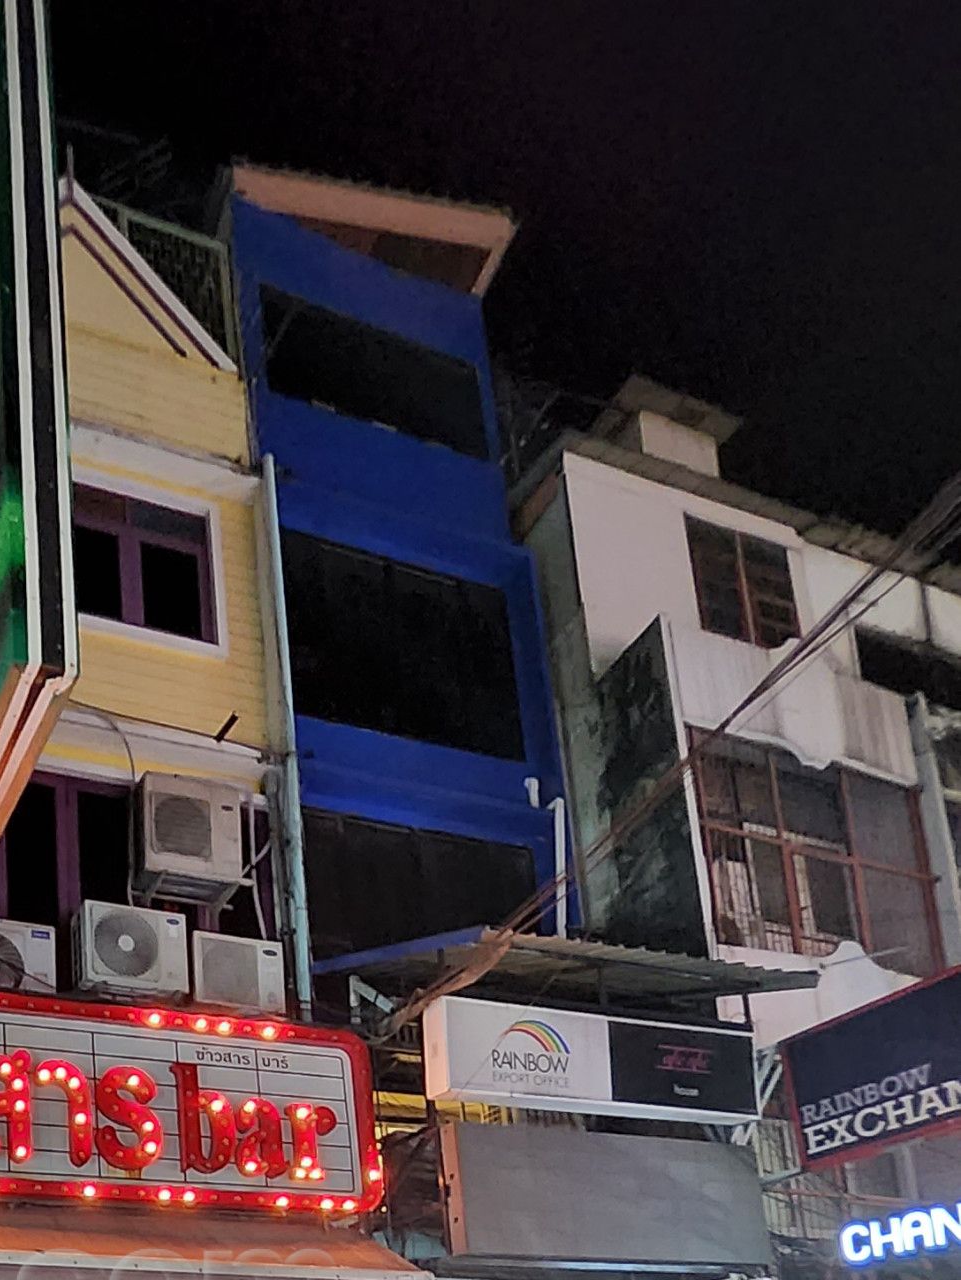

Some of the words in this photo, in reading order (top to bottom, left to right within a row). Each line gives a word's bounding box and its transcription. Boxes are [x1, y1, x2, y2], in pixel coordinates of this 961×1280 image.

[195, 1046, 251, 1067] ข้าวสาร
[261, 1055, 290, 1070] บาร์
[491, 1048, 570, 1074] RAINBOW
[492, 1072, 530, 1084] EXPORT
[533, 1075, 570, 1089] OFFICE
[801, 1063, 932, 1125] RAINBOW
[169, 1062, 337, 1184] bar
[840, 1201, 961, 1264] CHAN
